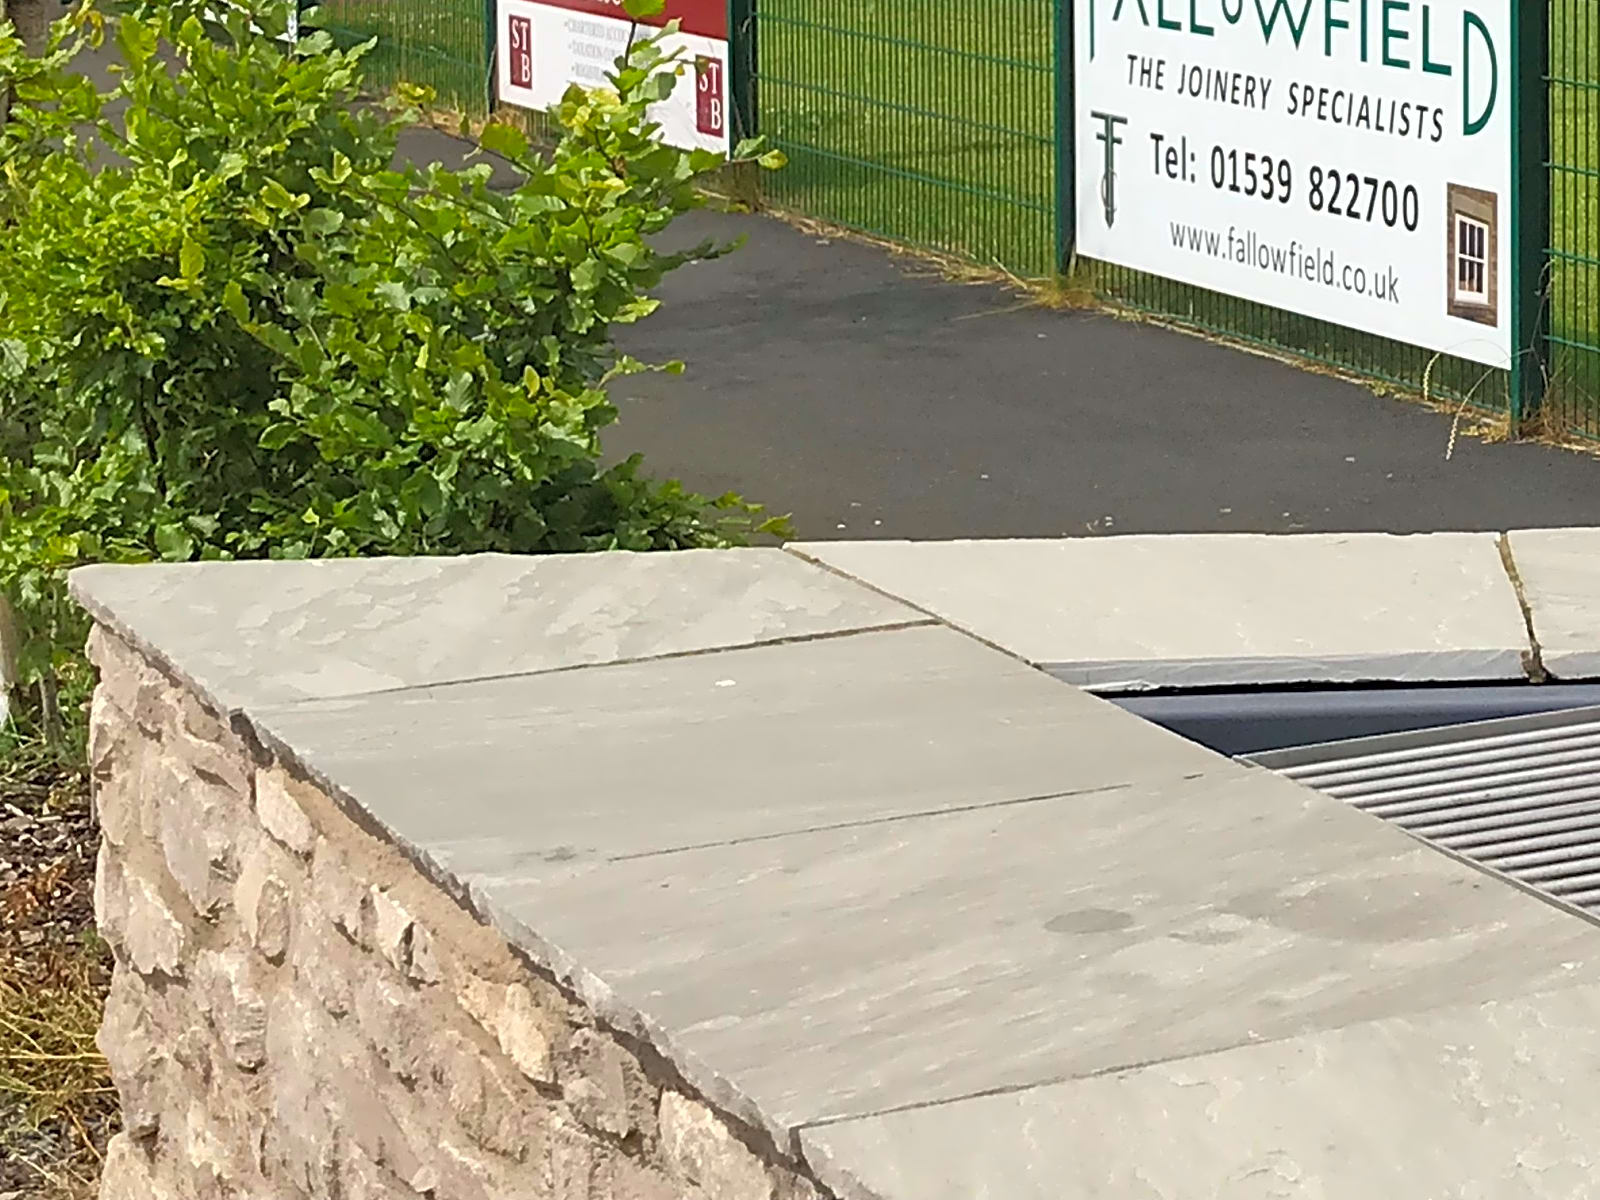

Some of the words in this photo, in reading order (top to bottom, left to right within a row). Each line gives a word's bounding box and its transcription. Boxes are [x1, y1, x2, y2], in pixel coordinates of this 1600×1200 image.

[1126, 54, 1166, 92] THE
[1178, 61, 1272, 111] JOINERY
[1287, 81, 1444, 143] SPECIALISTS
[1150, 132, 1197, 184] Tel:
[1211, 144, 1293, 205] 01539
[1308, 165, 1420, 233] 822700
[1170, 221, 1400, 304] www.fallowfield.co.uk
